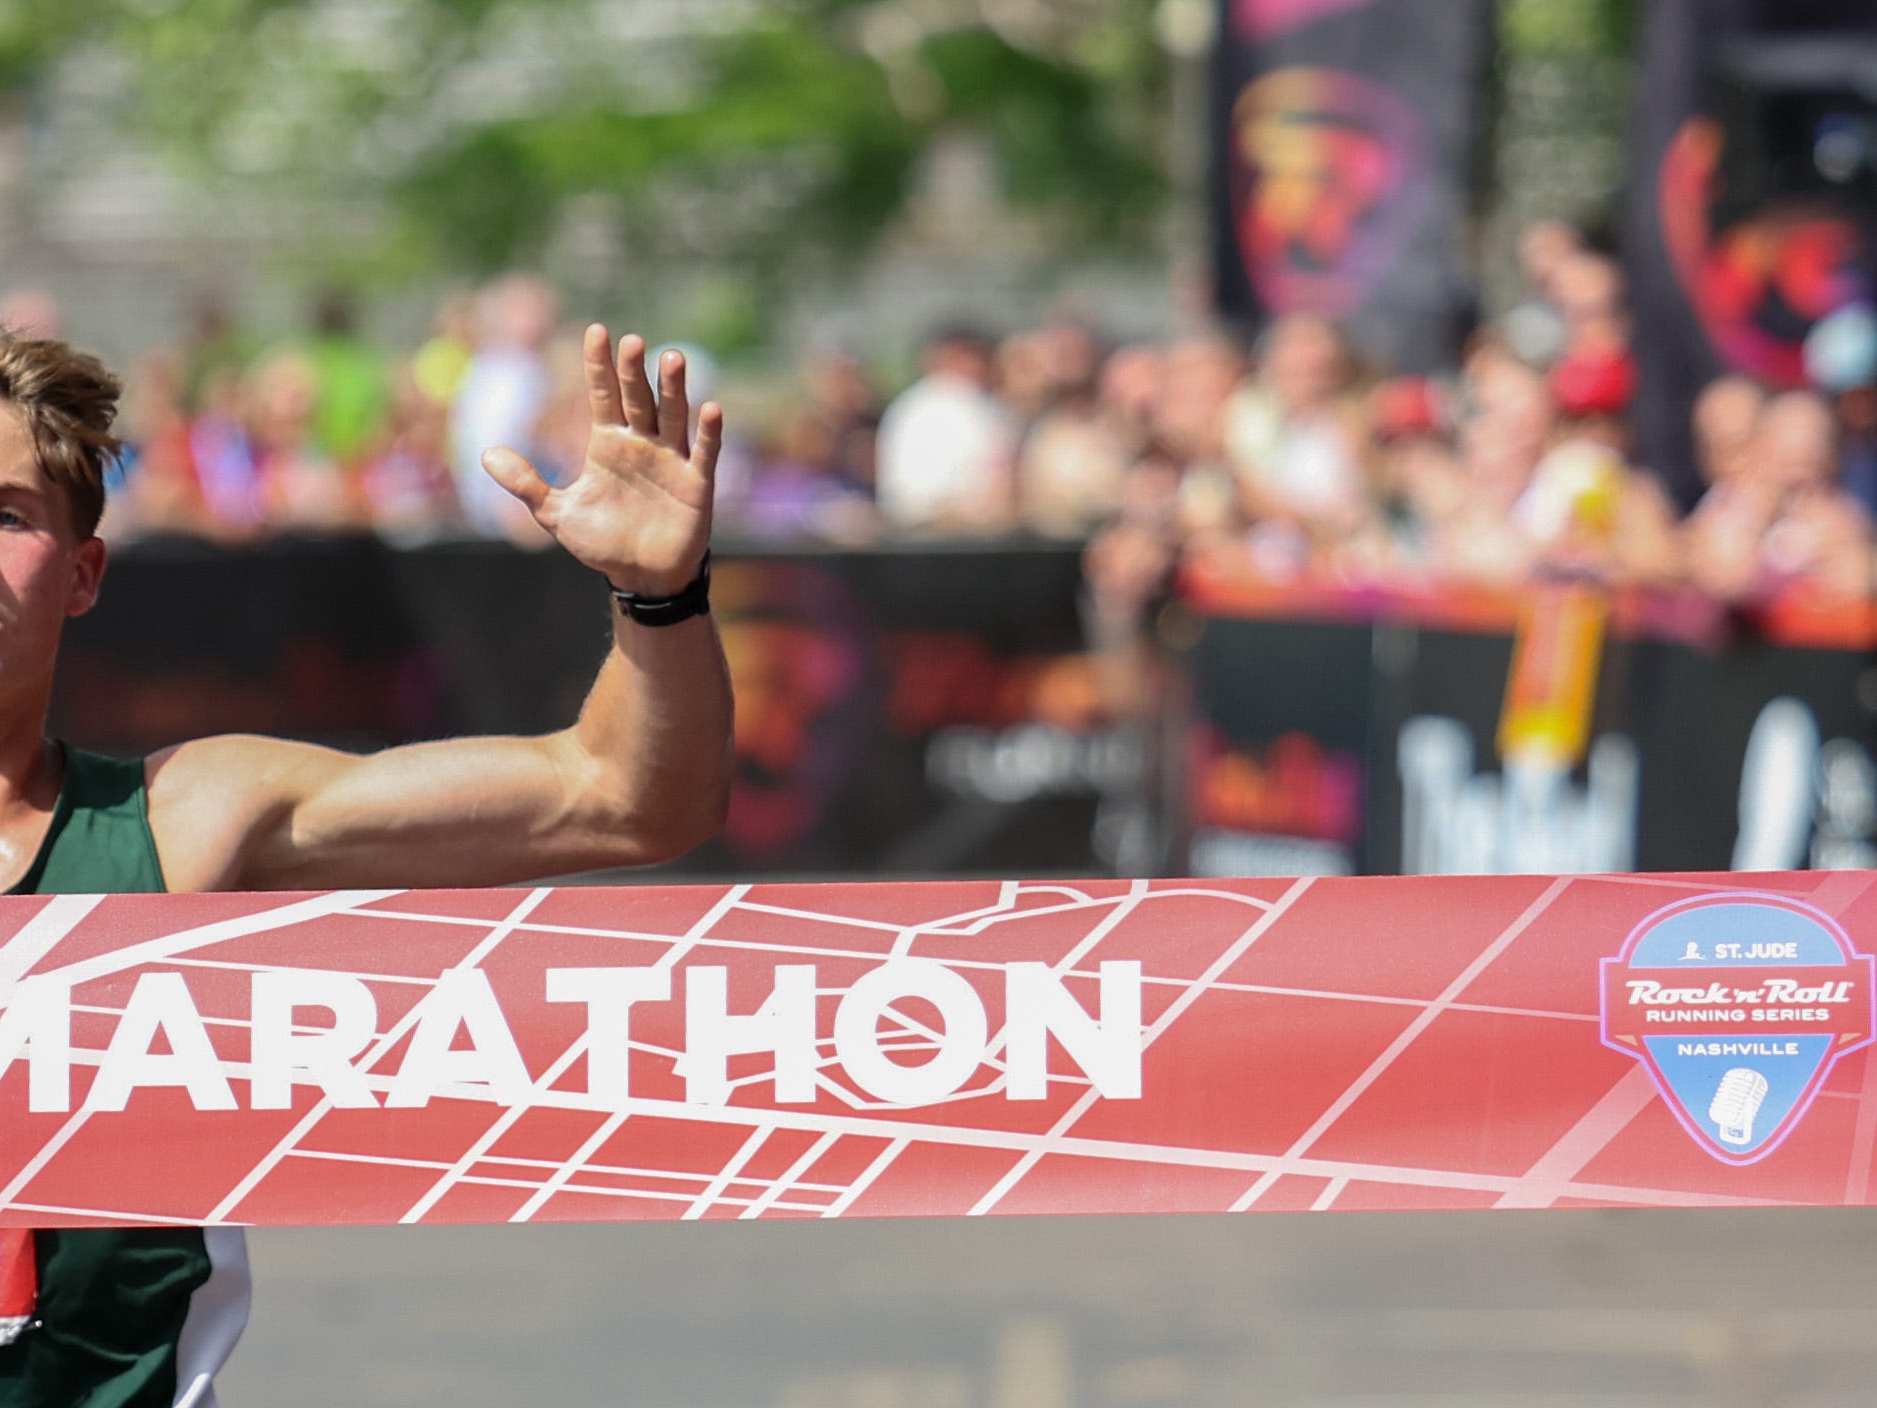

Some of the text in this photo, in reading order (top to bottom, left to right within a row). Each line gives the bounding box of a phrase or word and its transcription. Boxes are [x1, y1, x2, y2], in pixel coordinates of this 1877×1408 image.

[1715, 942, 1798, 959] ST. JUDE
[1646, 1008, 1830, 1023] RUNNING SERIES
[1678, 1042, 1799, 1057] NASHVILLE
